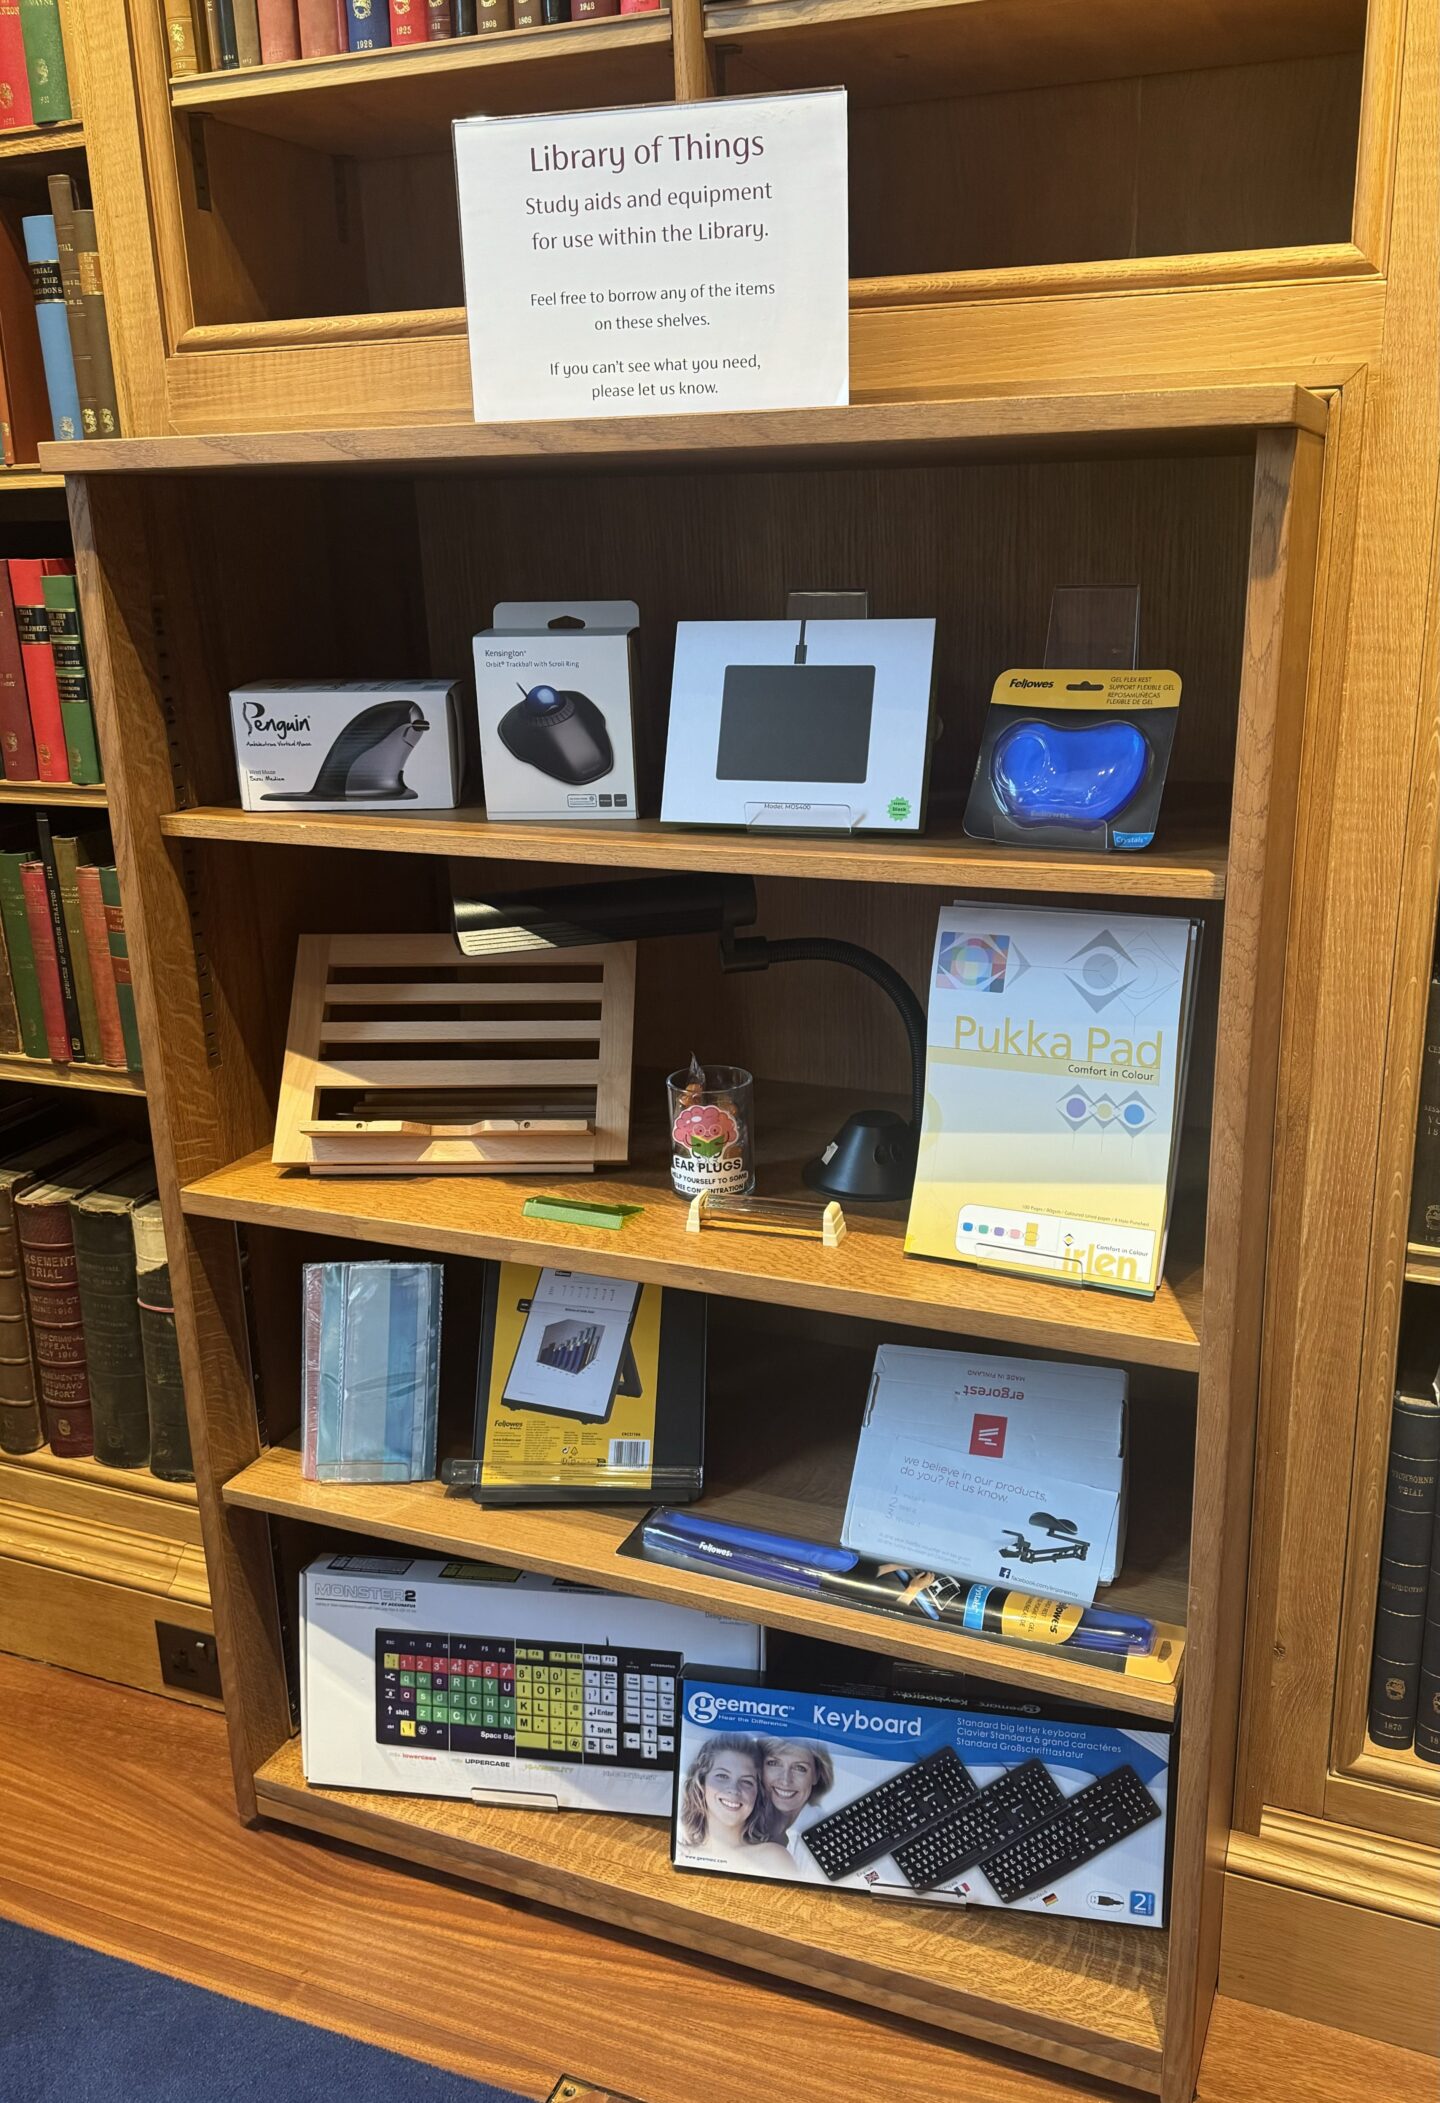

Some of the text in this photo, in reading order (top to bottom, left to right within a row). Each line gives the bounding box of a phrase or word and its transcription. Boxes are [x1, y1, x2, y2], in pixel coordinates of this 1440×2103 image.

[396, 26, 412, 35] 1925
[357, 39, 373, 49] 1928
[530, 133, 765, 174] Library of Things
[525, 182, 773, 217] Study aids and equipment
[531, 221, 769, 250] for use within the Library.
[530, 281, 776, 306] Feel free to borrow any of the items
[594, 312, 710, 331] on these shelves.
[550, 354, 761, 378] If you can't see what you need,
[591, 381, 718, 400] please let us know.
[1009, 679, 1054, 689] Fellowes
[243, 702, 310, 739] Penguin
[955, 1015, 1163, 1069] Pukka Pad
[1068, 1064, 1154, 1081] Comfort in Colour
[675, 1157, 741, 1173] EAR PLUGS
[683, 1175, 716, 1185] YOURSELF
[729, 1173, 748, 1182] SOME
[1097, 1244, 1120, 1253] Comfort
[24, 1255, 76, 1268] ASEMENT
[1062, 1243, 1137, 1280] irlen
[30, 1267, 62, 1278] TRIAL
[967, 1369, 996, 1379] FINLAND
[963, 1385, 1025, 1401] ergorest
[495, 1420, 523, 1428] Fellowes
[901, 1466, 1009, 1504] do you? let us know.
[904, 1455, 1047, 1502] we believe in our products,
[699, 1541, 731, 1557] Fellowes
[315, 1583, 416, 1602] MONSTER2
[751, 1718, 788, 1727] Difference
[813, 1705, 922, 1736] Keyboard
[957, 1718, 1086, 1740] Standard big letter keyboard
[480, 1731, 515, 1740] Space Bar
[597, 1726, 612, 1734] Shift
[957, 1728, 988, 1738] Clavier
[990, 1732, 1031, 1743] Standard
[1041, 1738, 1070, 1748] grand
[956, 1738, 1084, 1759] Standard Großschrifttastatur
[465, 1759, 510, 1767] UPPERCASE
[1134, 1893, 1147, 1911] 2
